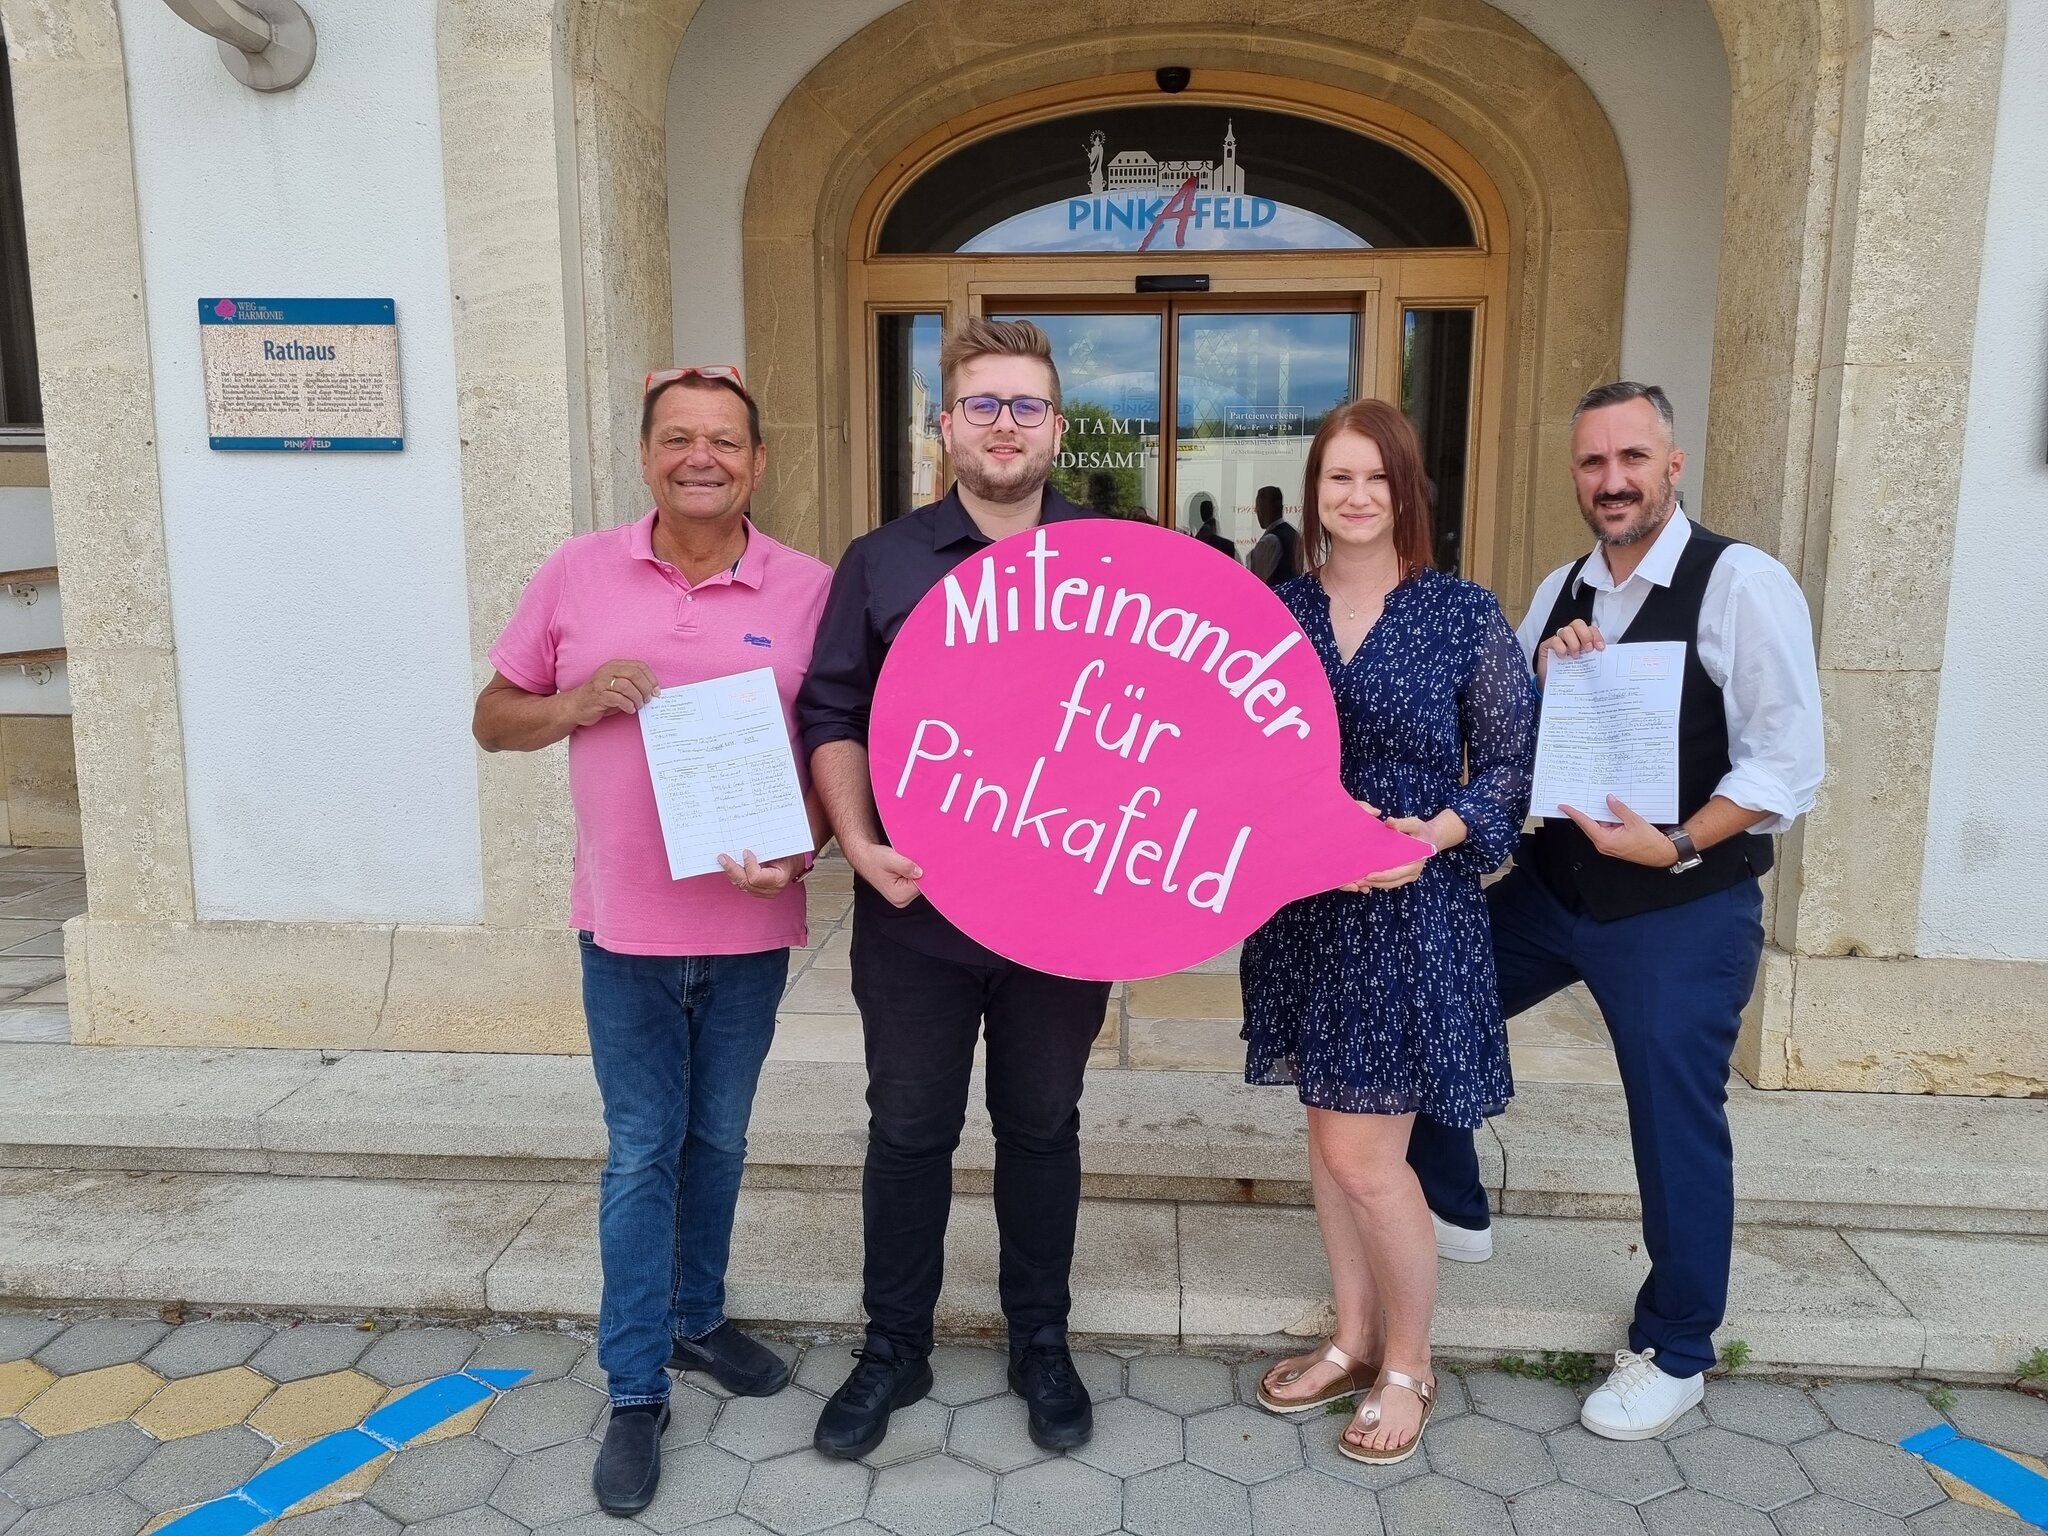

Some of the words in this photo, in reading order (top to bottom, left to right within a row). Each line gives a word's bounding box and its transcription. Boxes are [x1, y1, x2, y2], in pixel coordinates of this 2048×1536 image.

[1069, 176, 1277, 252] PINKAFELD
[237, 302, 256, 311] WEG
[238, 311, 284, 320] HARMONIE
[263, 339, 336, 361] Rathaus
[1230, 411, 1299, 420] Parteienverkehr
[284, 436, 331, 451] PINKAFELD
[943, 529, 1311, 741] Miteinander
[1054, 659, 1181, 764] für
[895, 720, 1253, 915] Pinkafeld
